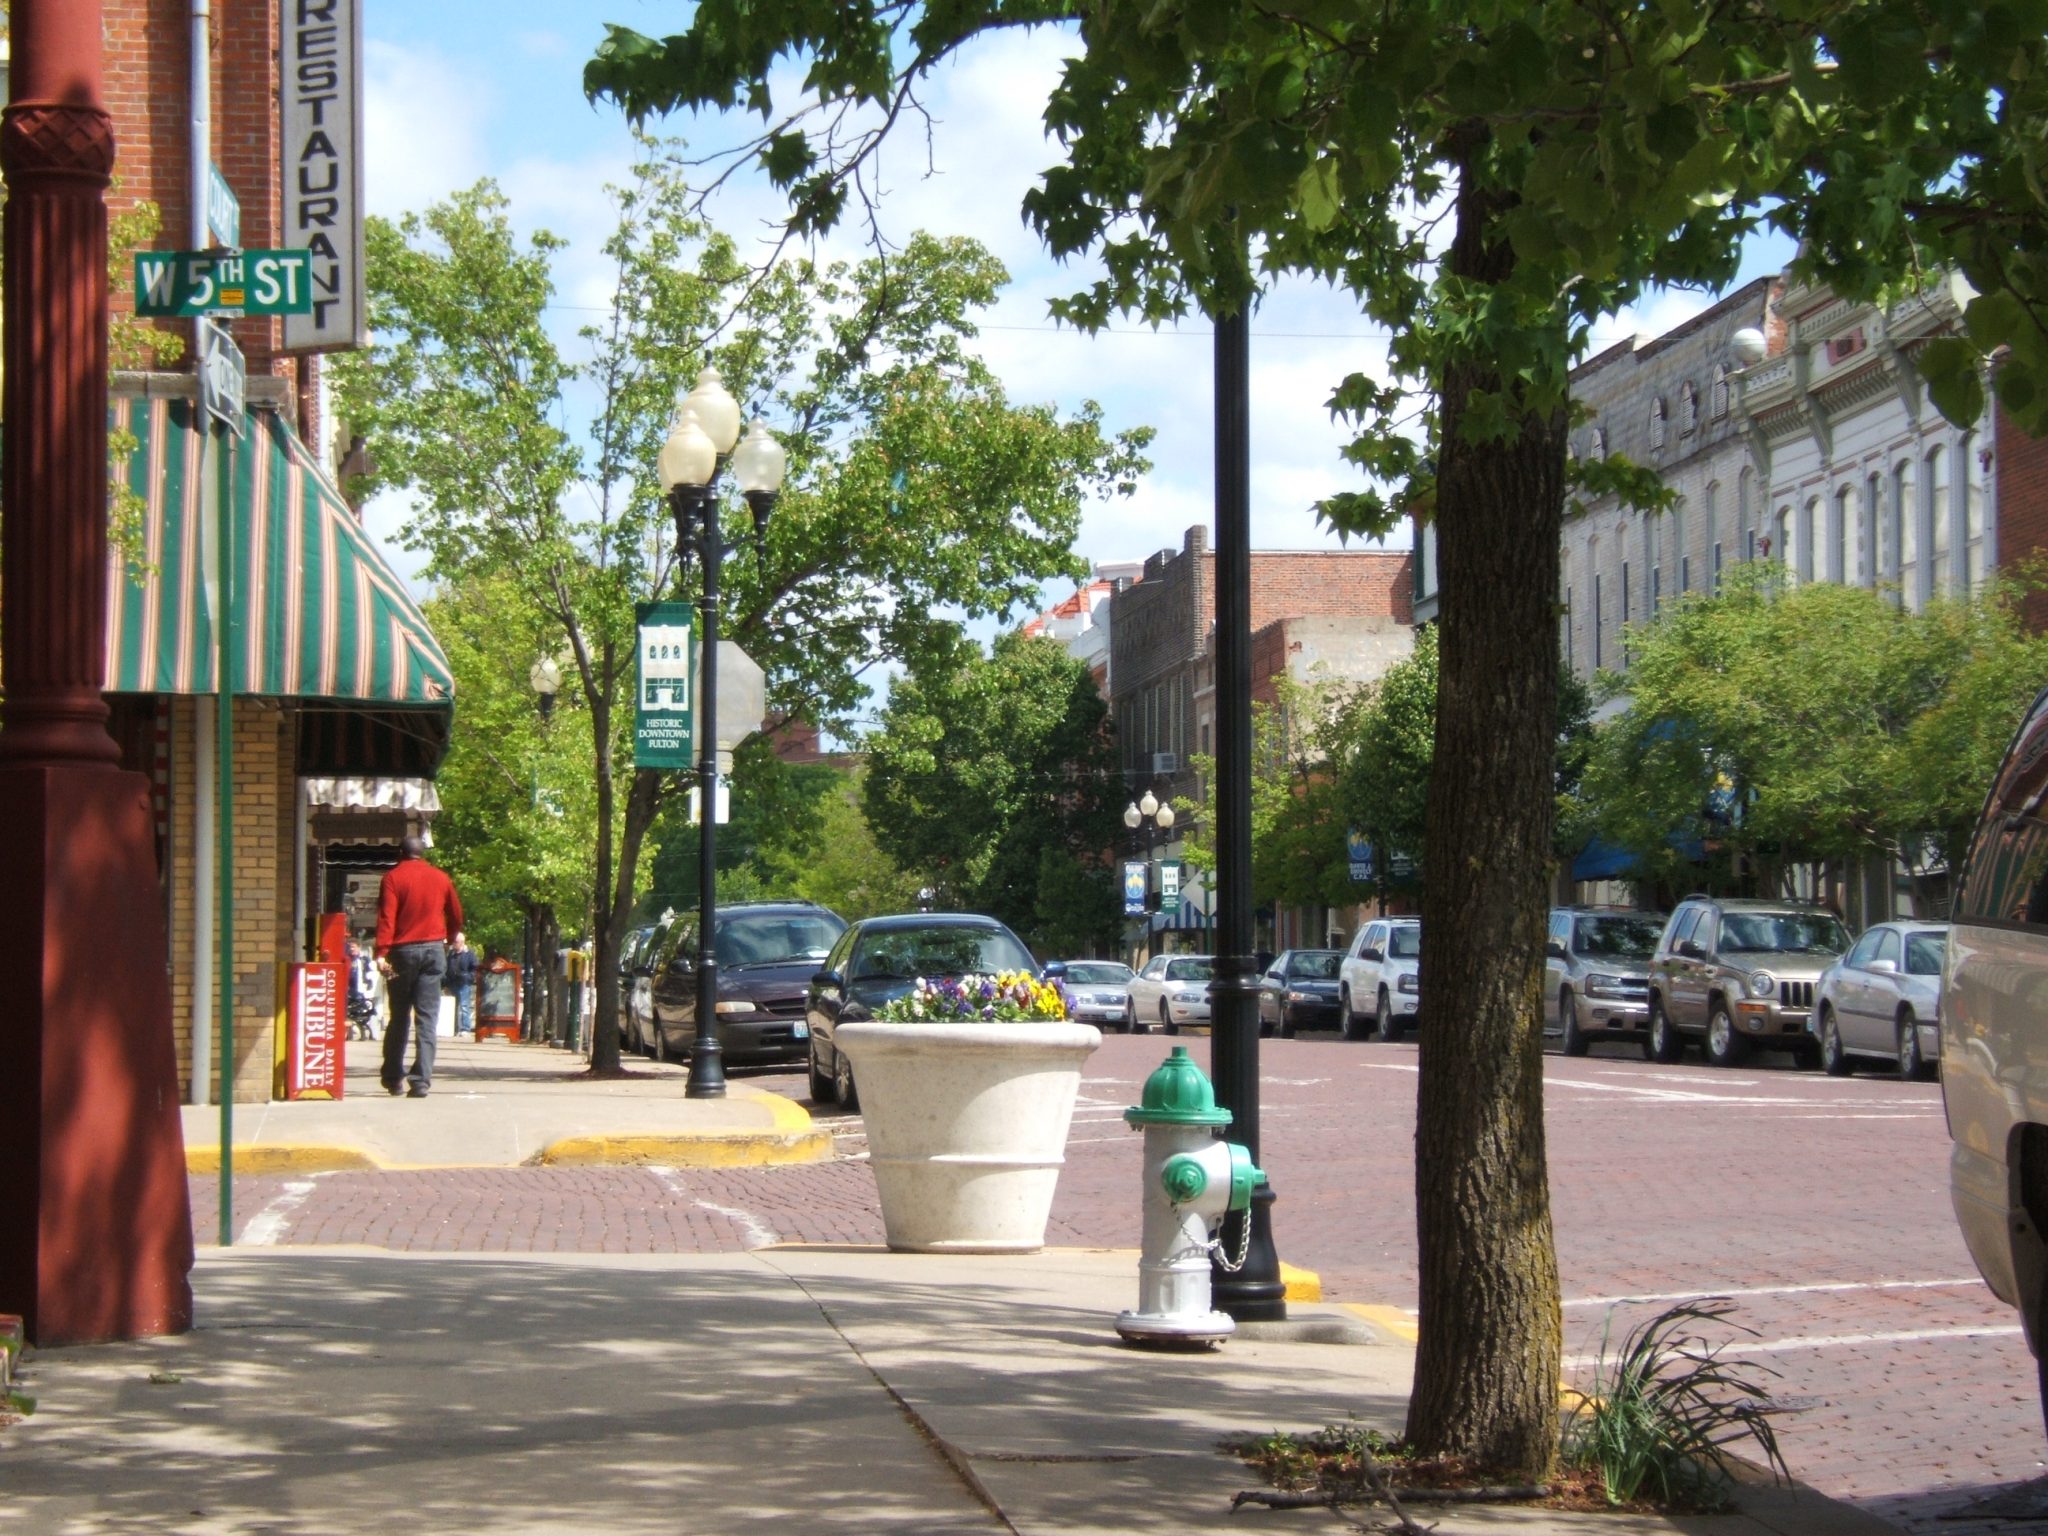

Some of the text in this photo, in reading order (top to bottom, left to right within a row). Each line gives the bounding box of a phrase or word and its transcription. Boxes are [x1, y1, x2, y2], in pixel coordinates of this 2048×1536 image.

[297, 0, 339, 329] RESTAURANT
[142, 258, 303, 306] W 5TH ST
[639, 729, 690, 738] DOWNTOWN
[646, 719, 683, 728] HISTORIC
[649, 739, 679, 748] FULTON
[304, 968, 327, 1088] TRIBUNE
[325, 970, 336, 1086] COLUMBIA DAILY
